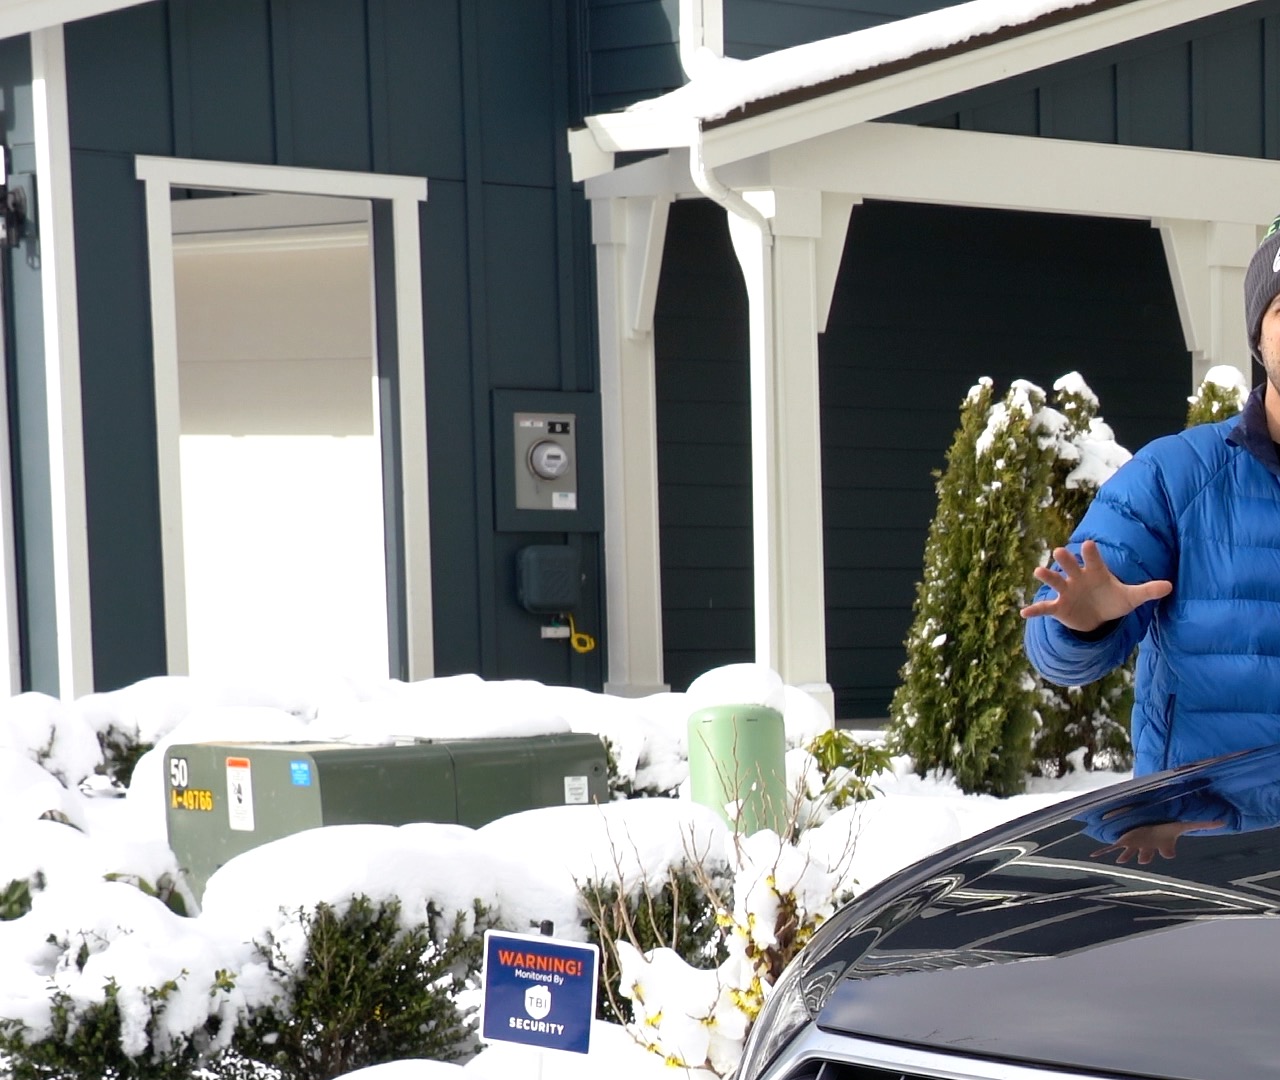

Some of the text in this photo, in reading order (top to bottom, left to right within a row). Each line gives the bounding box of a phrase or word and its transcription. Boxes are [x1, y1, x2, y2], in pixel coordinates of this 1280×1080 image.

[170, 757, 188, 788] 50
[171, 789, 214, 811] A-49766
[498, 949, 583, 977] WARNING!
[515, 968, 565, 986] Monitored By
[528, 996, 548, 1009] TBI
[508, 1016, 565, 1036] SECURITY
